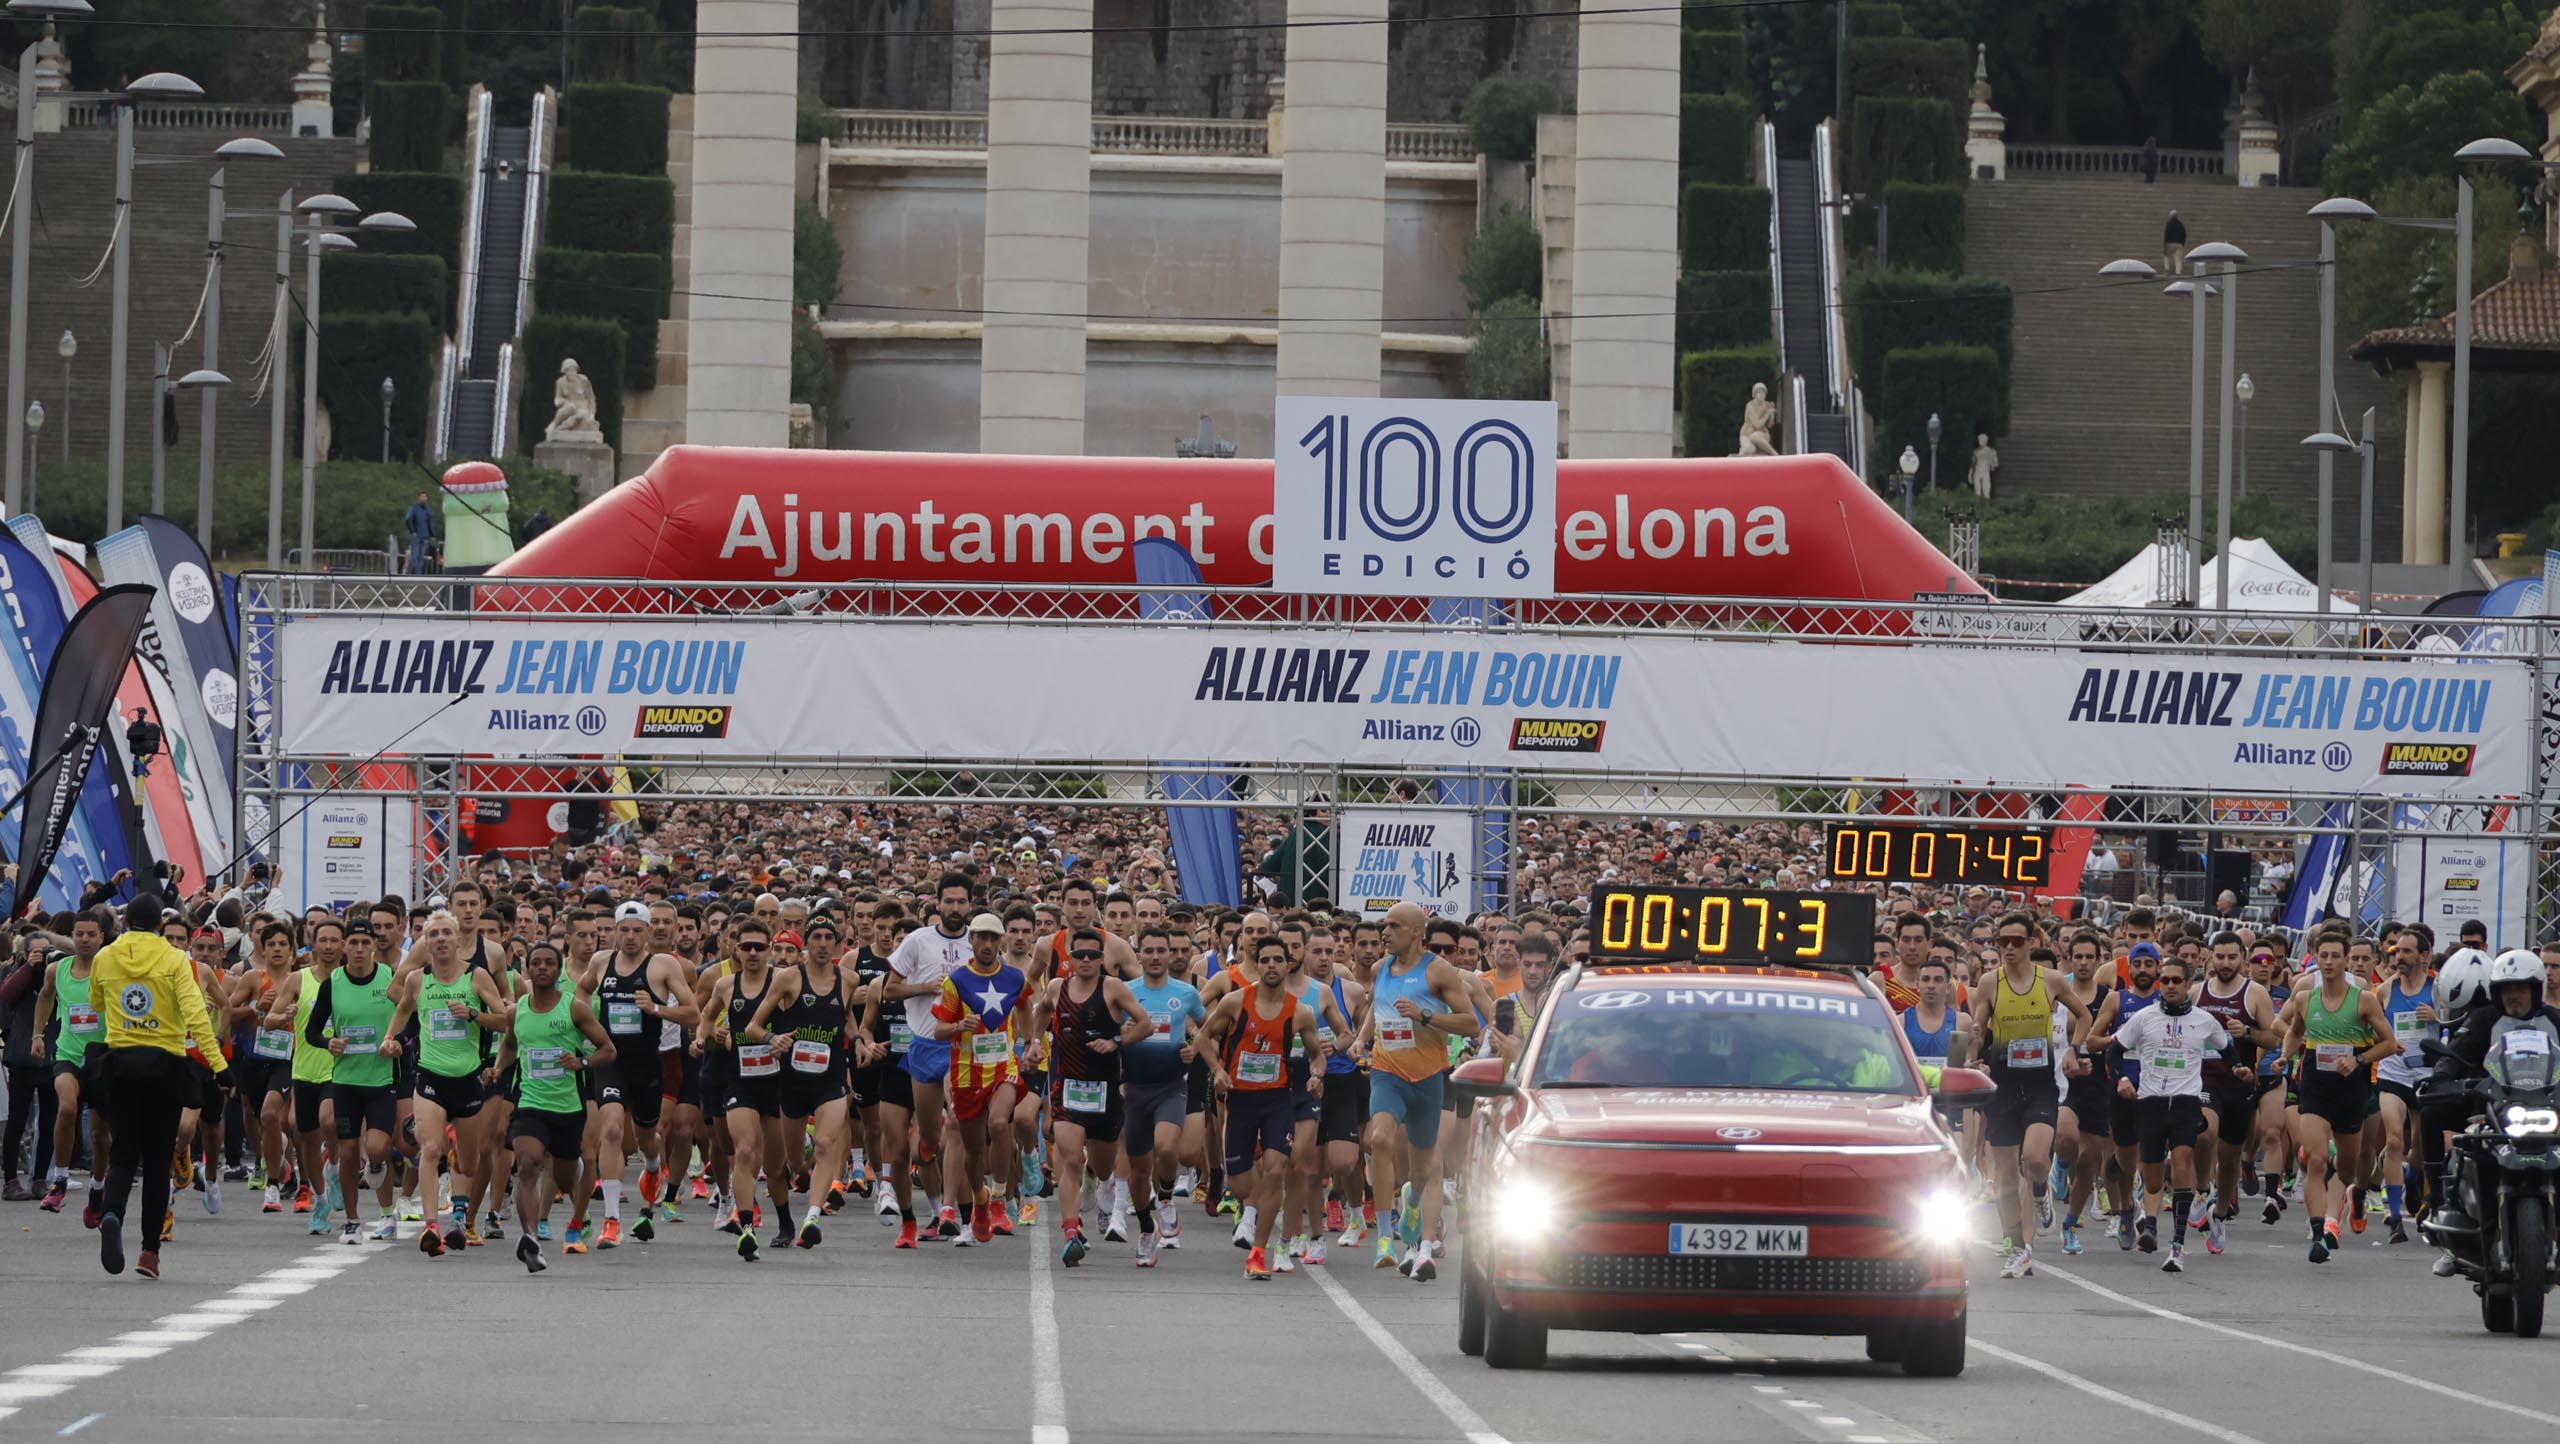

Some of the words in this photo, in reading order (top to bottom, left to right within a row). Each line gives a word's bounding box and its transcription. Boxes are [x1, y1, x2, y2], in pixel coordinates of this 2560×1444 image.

[1299, 415, 1534, 543] 100
[719, 494, 1216, 577] Ajuntament
[1556, 494, 1790, 560] elona
[1323, 549, 1530, 580] EDICIÓ
[320, 639, 494, 694] ALLIANZ
[495, 640, 603, 694] JEAN
[607, 640, 746, 695] BOUIN
[1195, 646, 1370, 703] ALLIANZ
[1370, 649, 1480, 705] JEAN
[1482, 651, 1622, 709] BOUIN
[2068, 668, 2243, 727] ALLIANZ
[2242, 673, 2351, 730] JEAN
[2353, 677, 2492, 734] BOUIN
[487, 709, 570, 731] Allianz
[643, 723, 705, 733] DEPORTIVO
[645, 708, 724, 725] MUNDO
[1362, 719, 1445, 741] Allianz
[1517, 736, 1580, 747] DEPORTIVO
[1519, 721, 1599, 739] MUNDO
[2233, 742, 2316, 766] Allianz
[2387, 760, 2449, 772] DEPORTIVO
[2389, 745, 2469, 764] MUNDO
[322, 813, 355, 824] Allianz
[1363, 823, 1436, 847] ALLIANZ
[1355, 848, 1400, 871] JEAN
[1909, 831, 2043, 882] 07:42
[2440, 856, 2473, 866] Allianz
[1349, 874, 1407, 898] BOUIN
[1600, 892, 1828, 957] 00:07:3
[1666, 990, 1859, 1018] HYUNDAI
[1687, 1228, 1748, 1250] 4392
[1756, 1230, 1801, 1252] MKM
